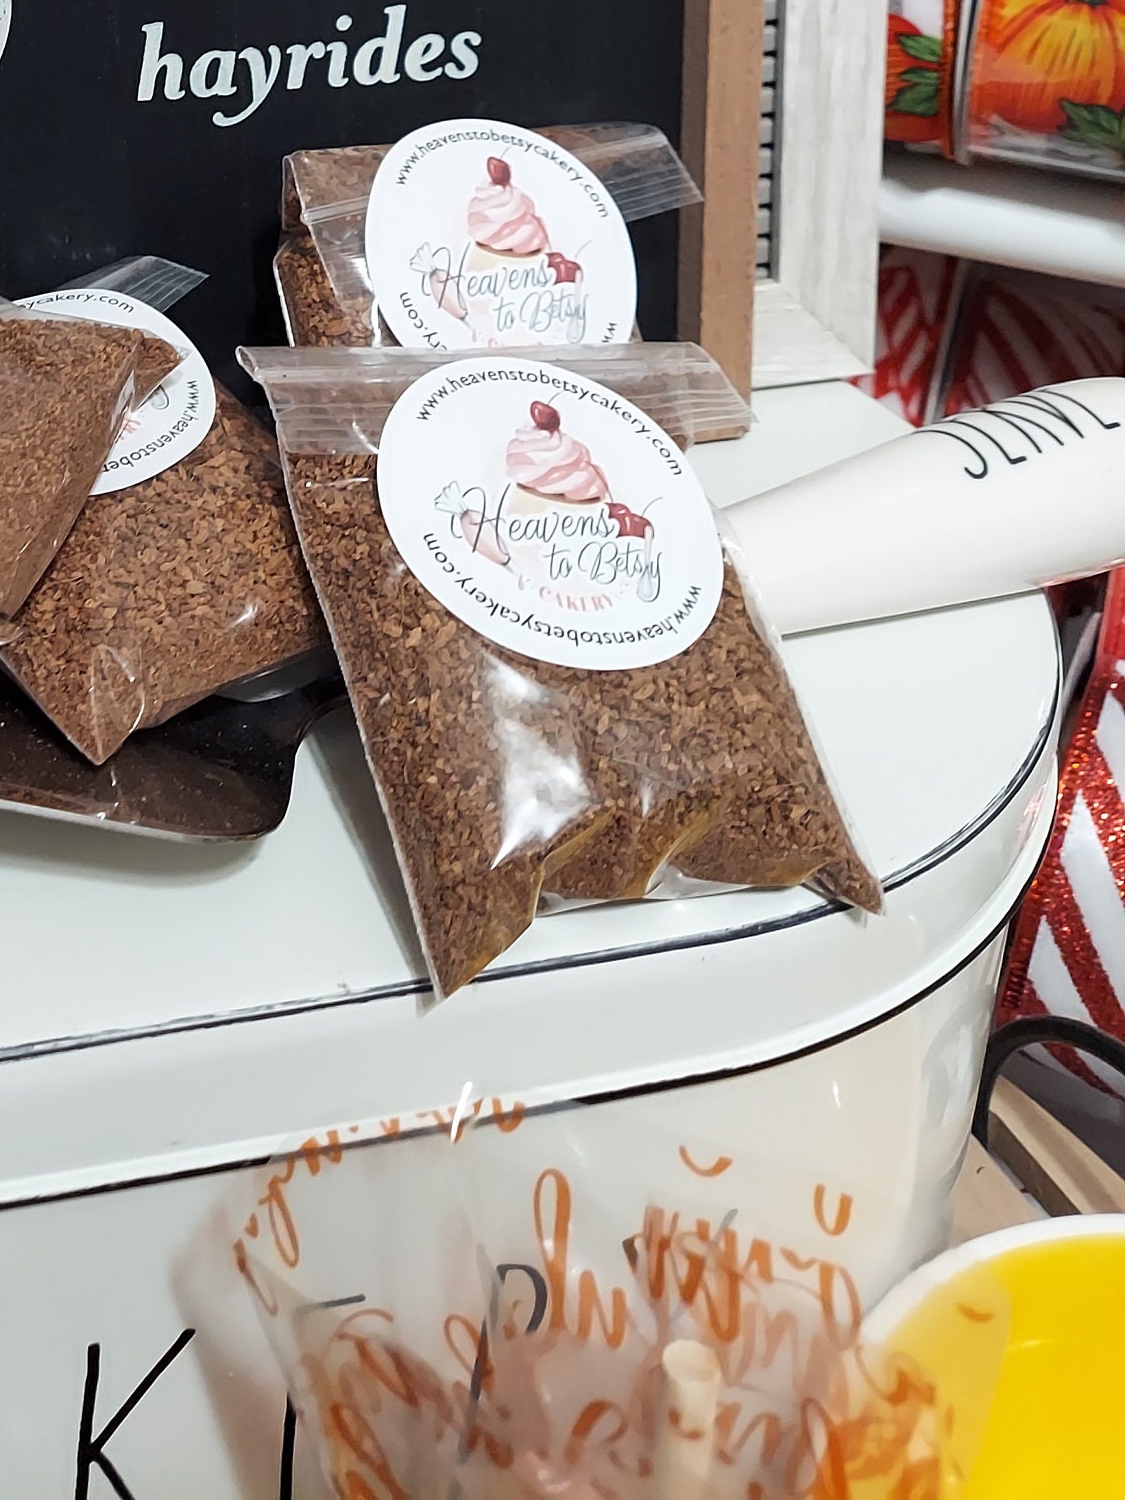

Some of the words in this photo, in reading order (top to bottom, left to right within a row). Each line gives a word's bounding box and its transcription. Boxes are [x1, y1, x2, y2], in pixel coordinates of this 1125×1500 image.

[138, 5, 482, 127] hayrides
[396, 129, 609, 218] www.heavenstobetsycakery.com
[421, 241, 553, 312] Heavens
[493, 297, 516, 332] to
[519, 287, 590, 344] Betsy
[416, 369, 683, 476] www.heavenstobetsycakery.com
[450, 483, 615, 554] Heavens
[423, 531, 703, 647] www.heavenstobetsycakery.com
[542, 543, 573, 581] to
[576, 541, 663, 602] Betsy
